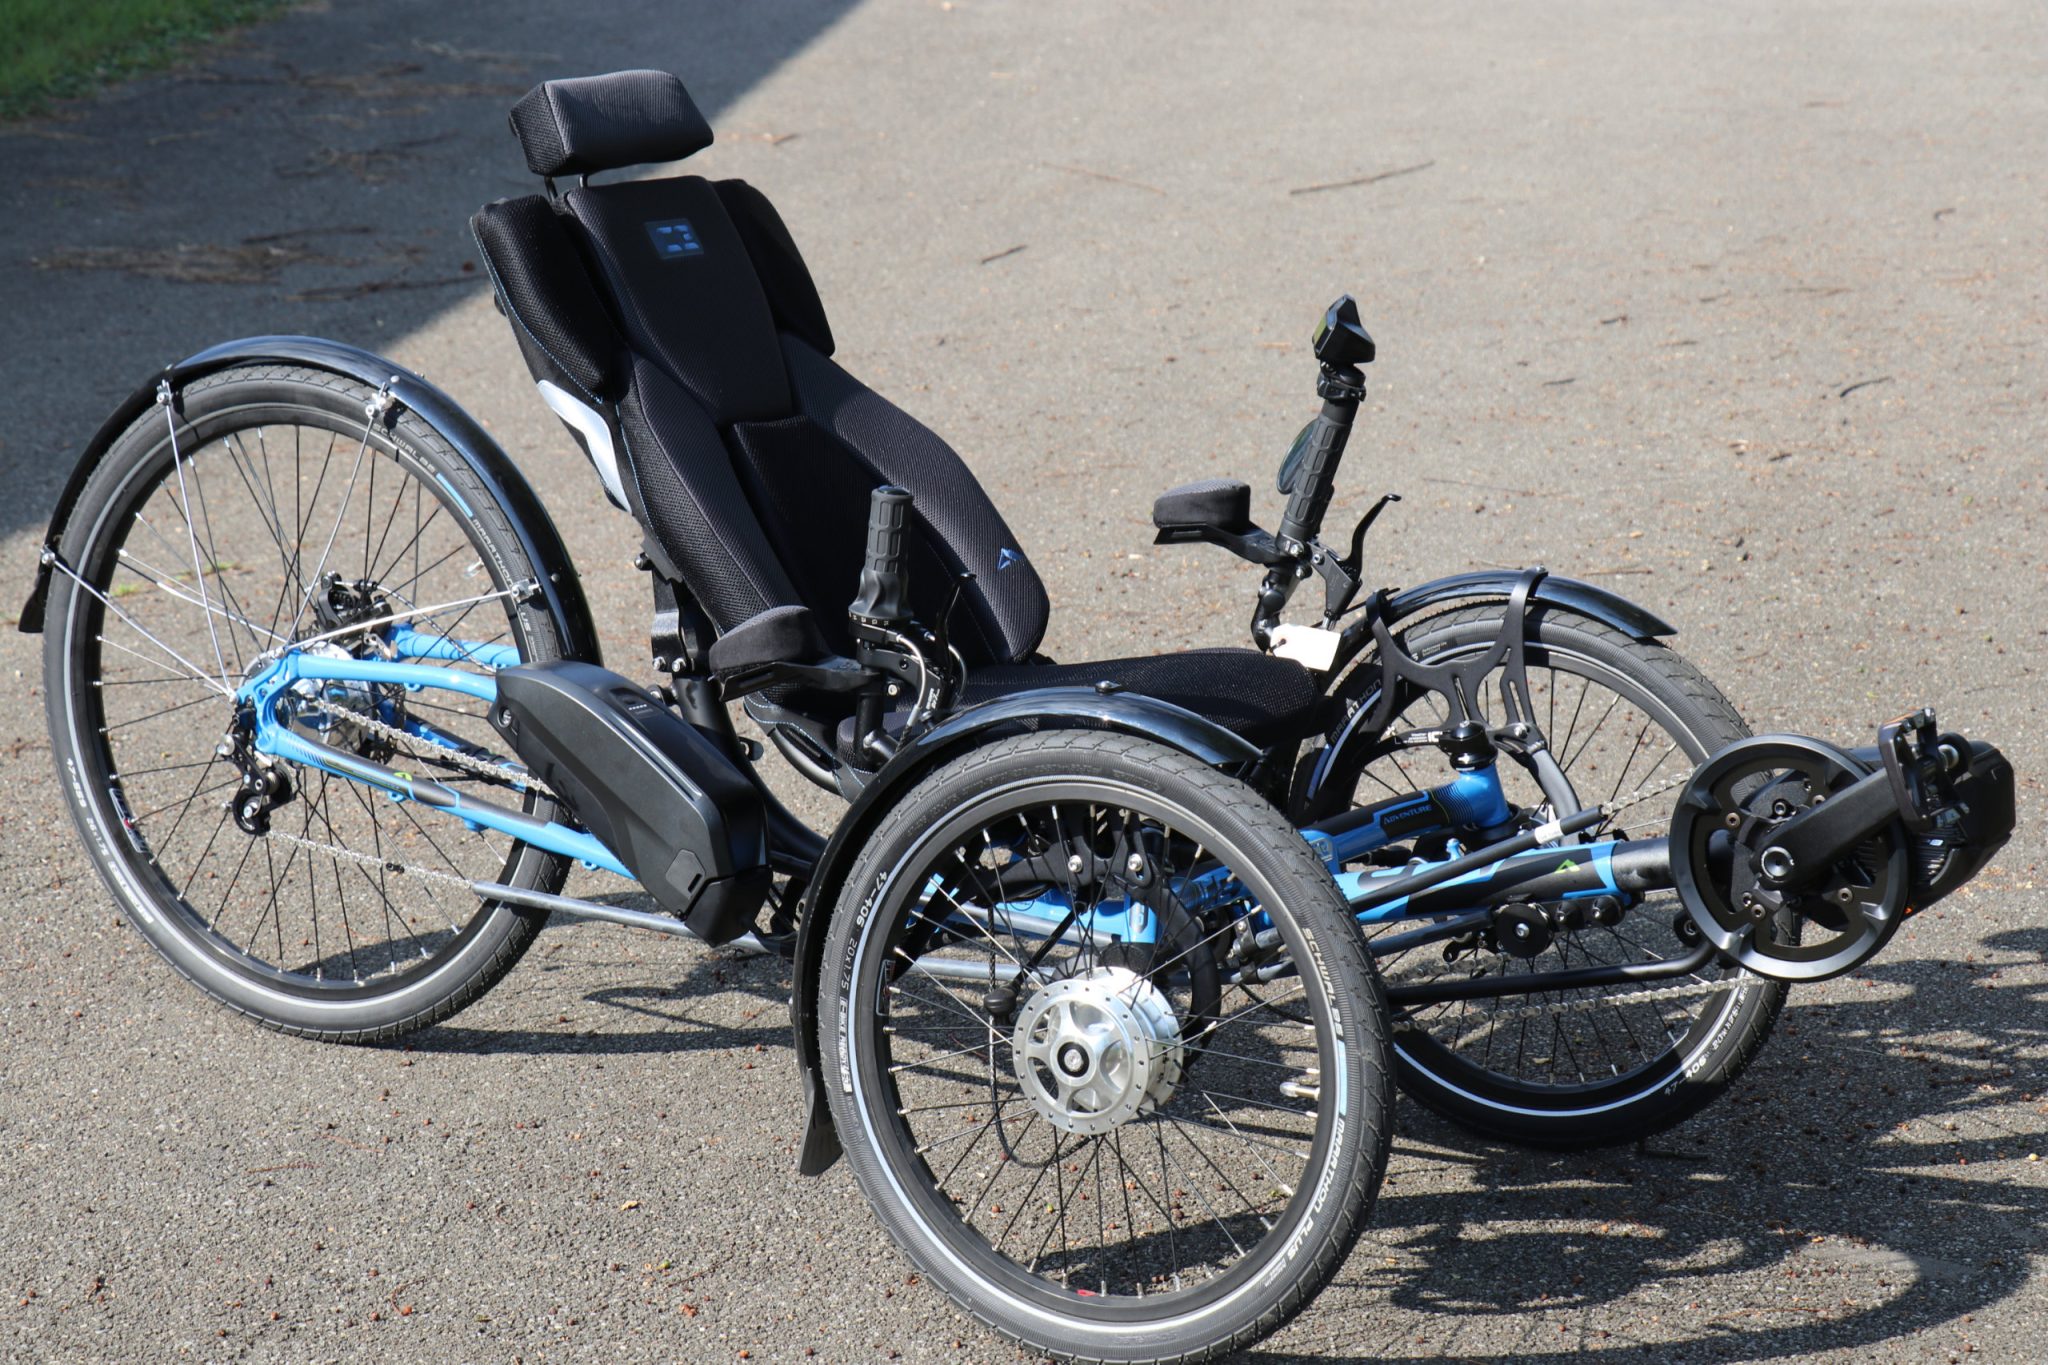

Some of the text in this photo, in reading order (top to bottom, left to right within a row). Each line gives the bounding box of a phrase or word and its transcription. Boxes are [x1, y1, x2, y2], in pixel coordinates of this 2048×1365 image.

[856, 871, 888, 928] 47-406
[841, 938, 858, 991] 20x1.75
[1302, 927, 1344, 1037] SCHWALBE
[1664, 1053, 1707, 1096] 47-406
[1287, 1118, 1346, 1262] MARATHON PLUS
